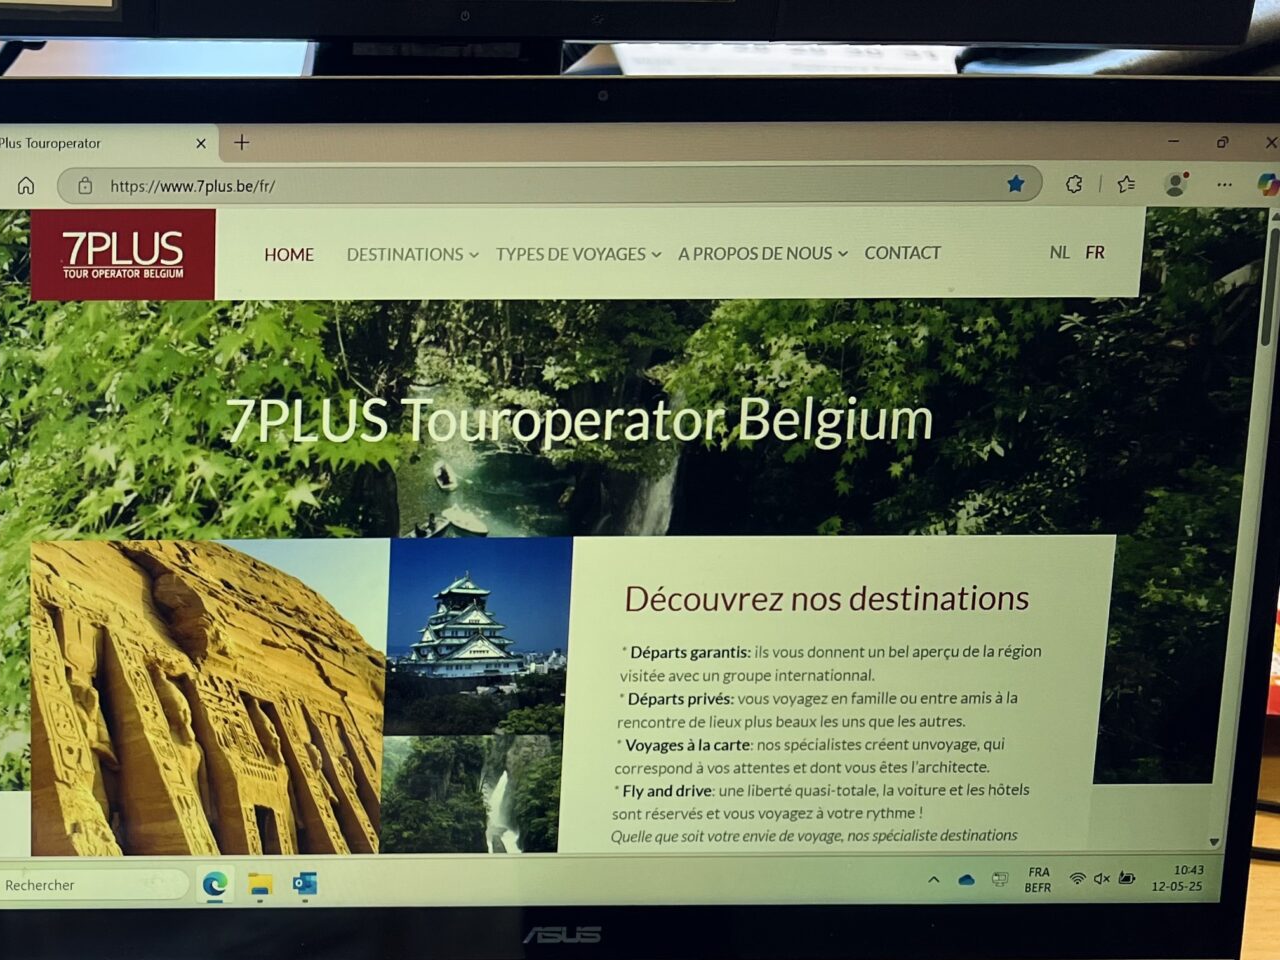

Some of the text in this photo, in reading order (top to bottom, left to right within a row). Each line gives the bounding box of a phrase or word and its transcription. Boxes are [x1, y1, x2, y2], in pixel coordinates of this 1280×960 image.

[24, 136, 102, 152] Touroperator
[110, 178, 276, 197] https://www.7plus.be/fr/
[62, 230, 184, 264] 7PLUS
[264, 247, 315, 262] HOME
[347, 247, 464, 262] DESTINATIONS
[495, 246, 647, 262] TYPES DE VOYAGES
[677, 245, 833, 261] A PROPOS DE NOUS
[864, 245, 943, 260] CONTACT
[1050, 245, 1105, 260] NL FR
[63, 268, 184, 280] TOUR OPERATOR BELGIUM
[226, 396, 932, 450] 7PLUS Touroperator Belgium
[625, 584, 1029, 612] Découvrez nos destinations
[630, 643, 1042, 662] Départs garantis: ils vous donnent un bel aperçu de la région
[619, 668, 875, 685] visitée avec un groupe internationnal.
[628, 690, 1018, 709] Départs privés: vous voyagez en famille ou entre amis à la
[617, 714, 966, 731] rencontre de lieux plus beaux les uns que les autres.
[625, 736, 1006, 755] Voyages à la carte: nos spécialistes créent unvoyage, qui
[614, 760, 991, 778] correspond à vos attentes et dont vous êtes l'architecte.
[622, 782, 1030, 801] Fly and drive: une liberté quasi-totale, la voiture et les hôtels
[611, 808, 643, 821] sont
[645, 806, 704, 821] réservés
[706, 808, 721, 820] et
[722, 809, 755, 820] vous
[757, 809, 814, 823] voyagez
[815, 806, 824, 820] à
[826, 807, 864, 820] votre
[866, 807, 916, 822] rythme
[610, 828, 1019, 846] Quelle que soit votre envie de voyage, nos spécialiste destinations
[1028, 866, 1051, 878] FRA
[1174, 864, 1205, 876] 10:43
[5, 878, 76, 892] Rechercher
[1024, 882, 1052, 894] BEFR
[1151, 880, 1203, 892] 12-05-25
[522, 926, 602, 944] ASUS
